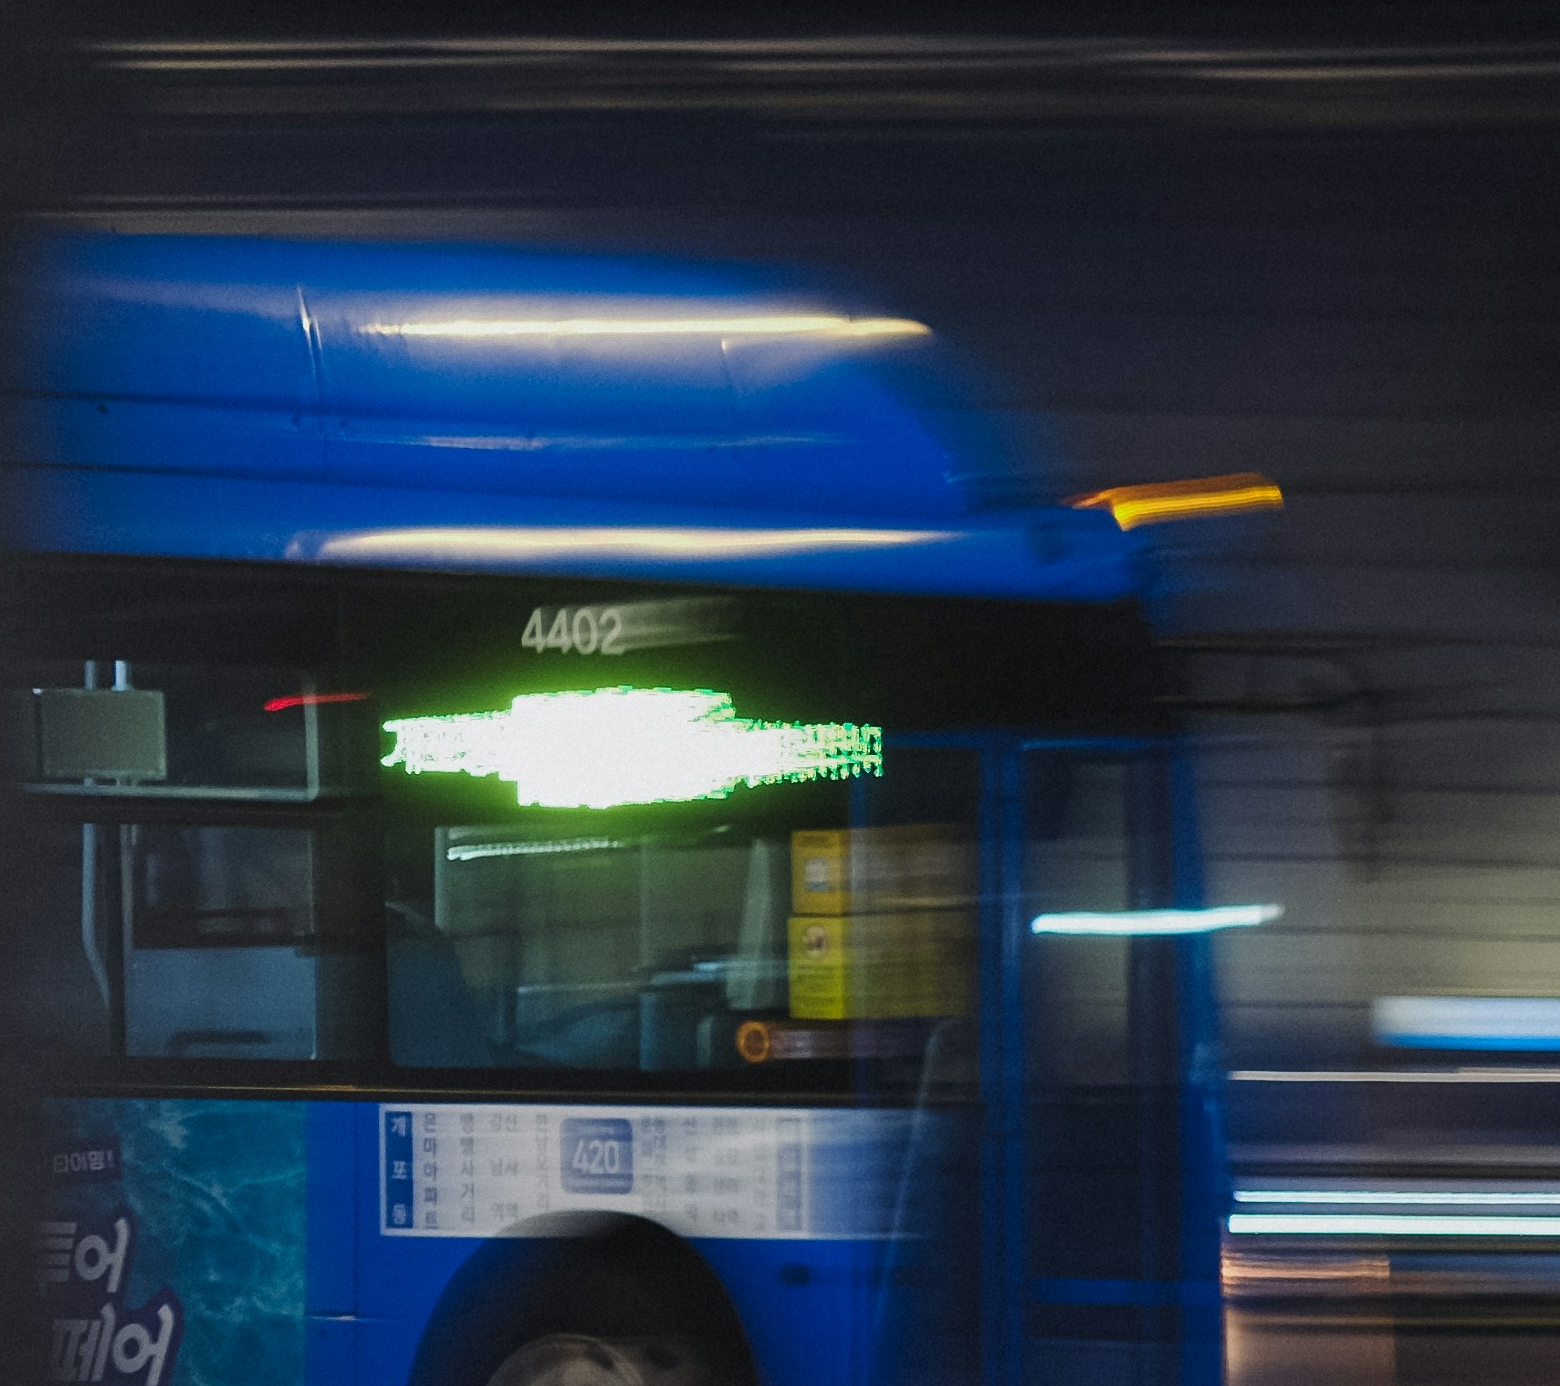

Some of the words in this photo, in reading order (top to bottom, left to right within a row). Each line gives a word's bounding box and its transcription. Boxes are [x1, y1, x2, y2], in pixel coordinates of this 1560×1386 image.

[522, 606, 624, 656] 4402
[390, 1115, 408, 1226] 개포동
[423, 1111, 439, 1230] 은마아파트
[572, 1139, 620, 1175] 420
